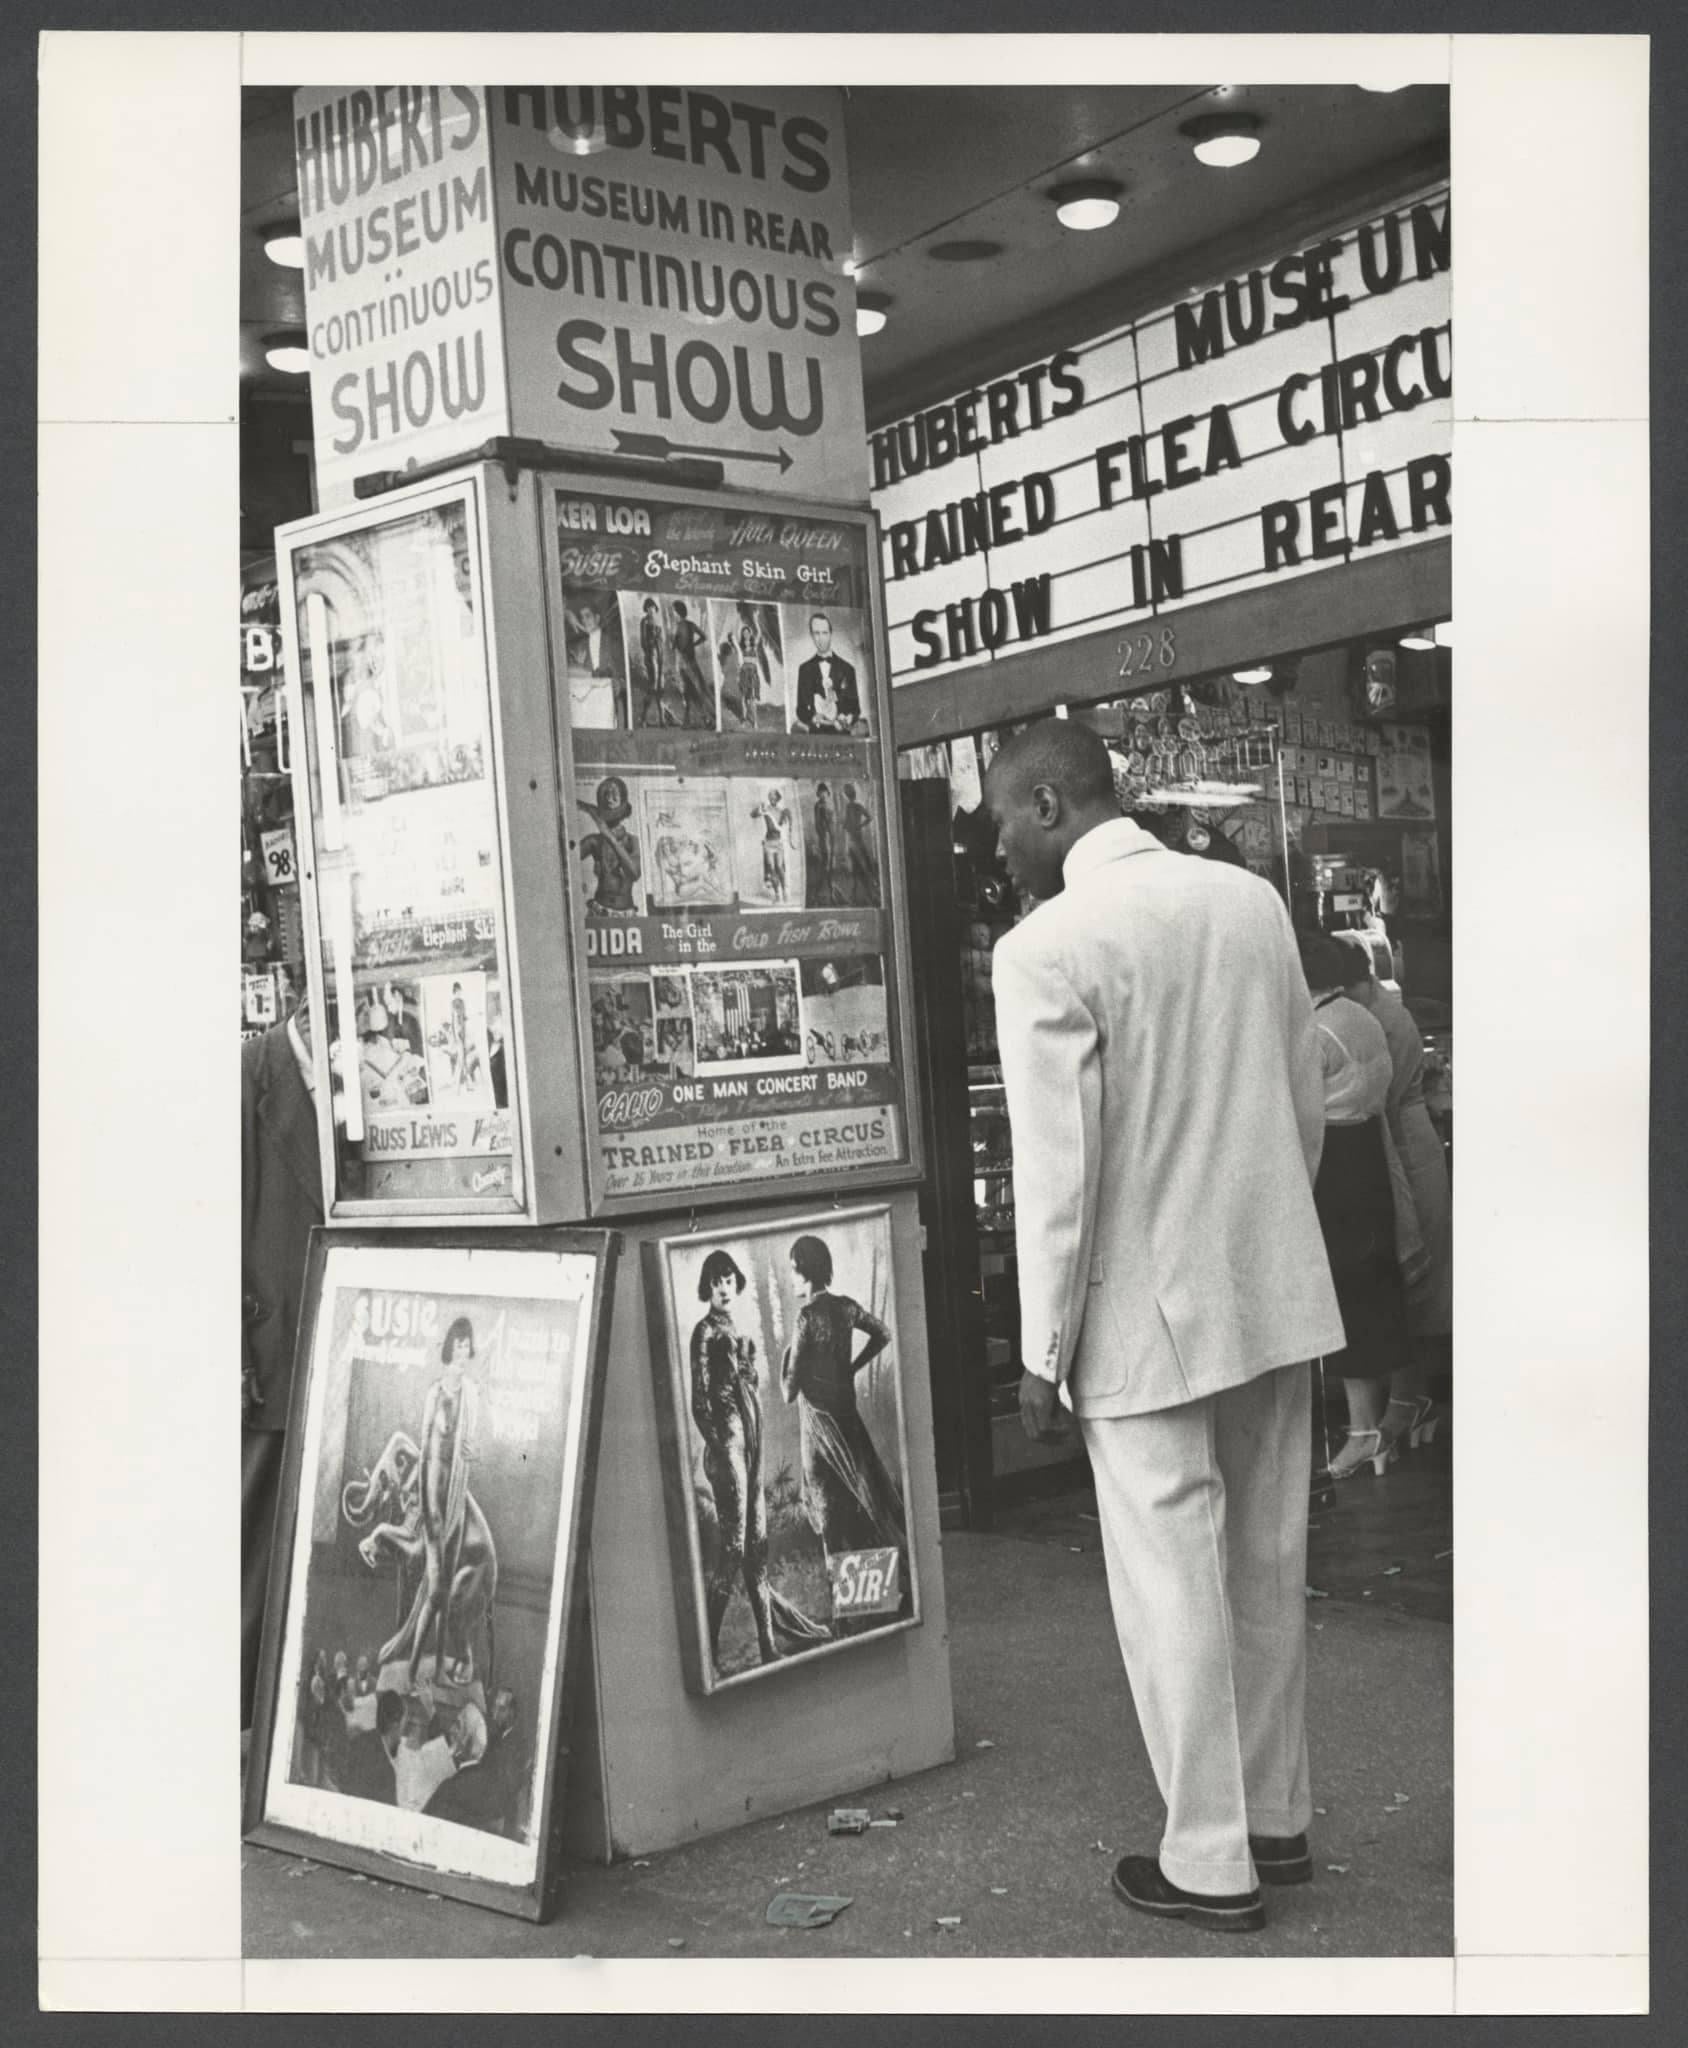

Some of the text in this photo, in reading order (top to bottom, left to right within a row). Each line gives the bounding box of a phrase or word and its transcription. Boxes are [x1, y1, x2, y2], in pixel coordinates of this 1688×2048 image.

[297, 86, 481, 218] HUBERTS
[505, 86, 832, 193] HUBERTS
[306, 167, 489, 292] MUSEUM
[514, 163, 834, 262] MUSEUM IN REAR
[312, 260, 494, 360] CONTINUOUS
[503, 227, 841, 337] CONTINUOUS
[332, 329, 487, 455] SHOW
[556, 319, 825, 437] SHOW
[871, 351, 1085, 491] HUBERTS
[605, 505, 651, 537] LOA
[882, 471, 1056, 582] RAINED
[1096, 404, 1241, 510] FLEA
[644, 549, 731, 578] Elephant
[742, 560, 786, 580] Skin
[796, 564, 834, 584] Girl
[911, 454, 1450, 667] SHOW IN REAR
[1117, 627, 1177, 678] 228
[269, 848, 291, 878] 98
[661, 923, 683, 939] The
[686, 922, 713, 938] Girl
[678, 938, 717, 953] in the
[673, 1083, 705, 1104] ONE
[713, 1080, 749, 1099] MAN
[756, 1074, 819, 1096] CONCERT
[827, 1070, 868, 1090] BAND
[367, 1123, 408, 1153] RUSS
[410, 1120, 458, 1149] LEWIS
[601, 1119, 886, 1171] TRAINED FLEA CIRCUS
[697, 1119, 788, 1138] Home of the
[775, 1153, 790, 1169] An
